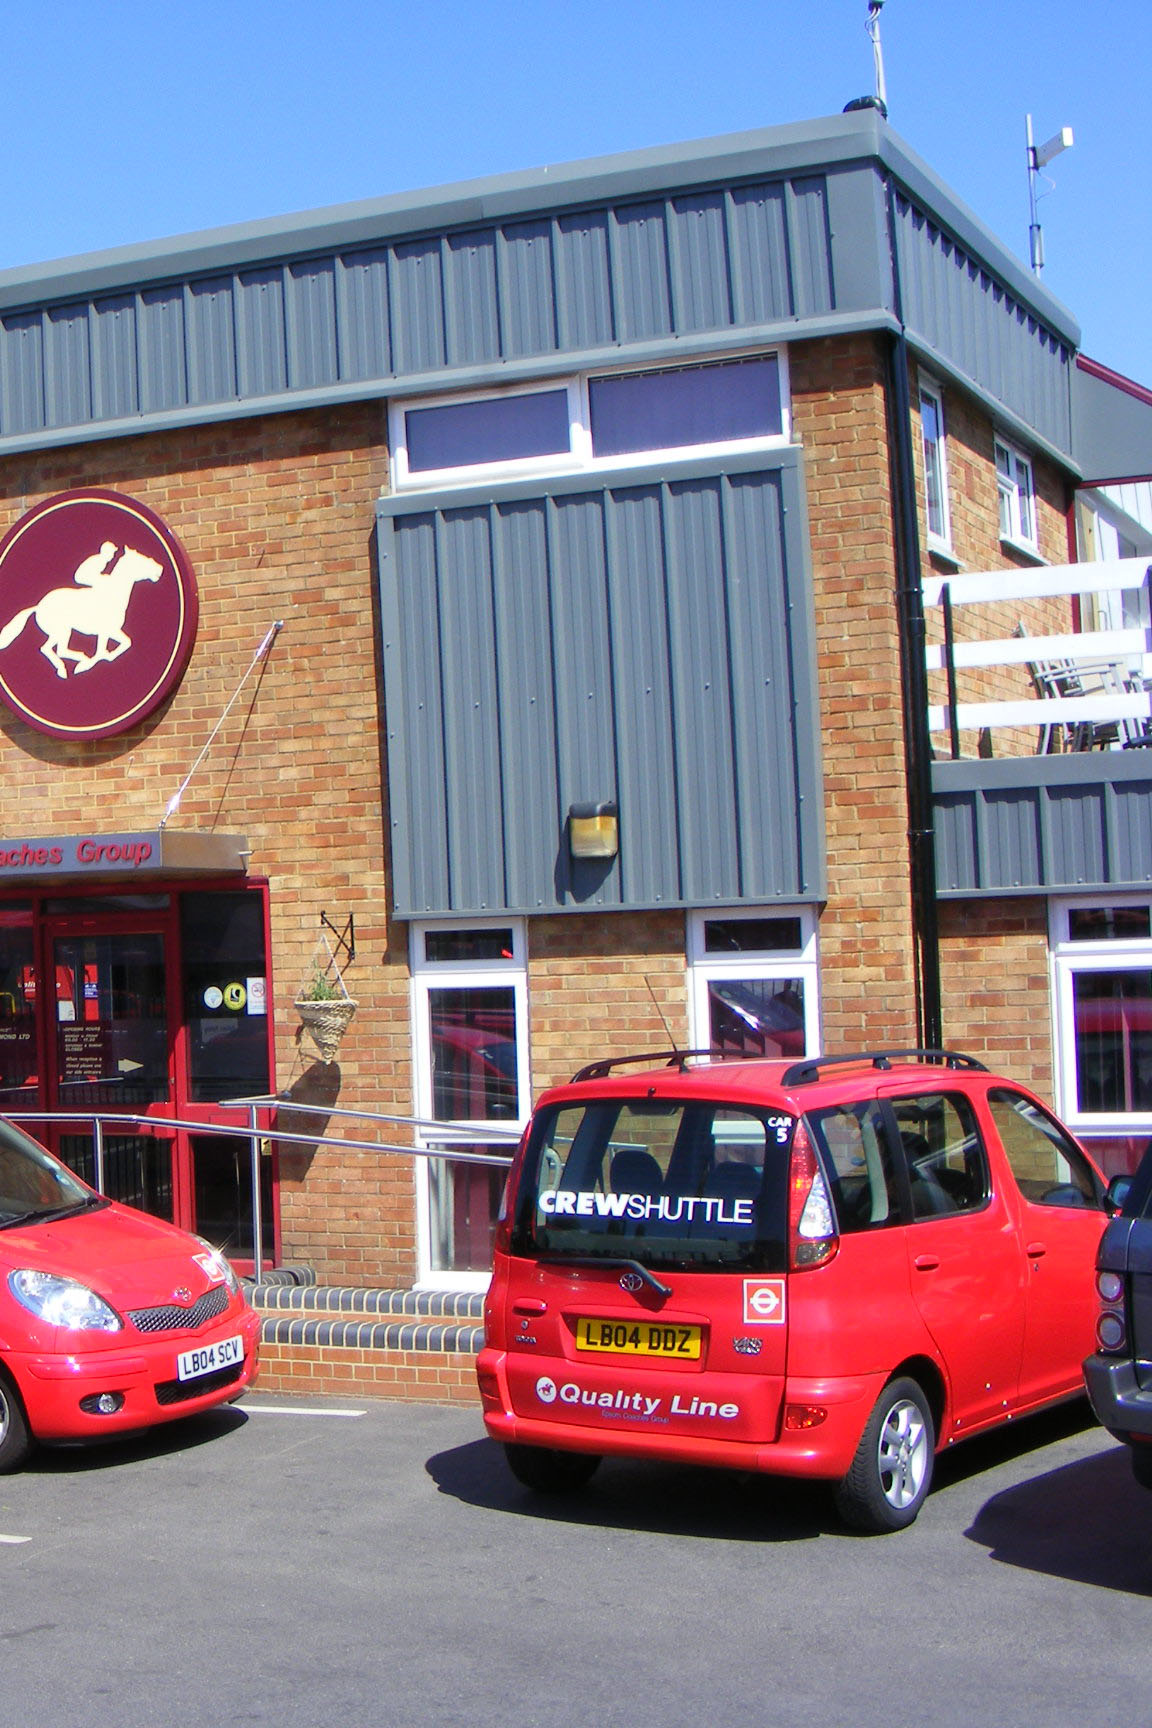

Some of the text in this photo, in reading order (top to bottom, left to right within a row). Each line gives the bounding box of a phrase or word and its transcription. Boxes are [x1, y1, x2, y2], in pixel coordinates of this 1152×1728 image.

[76, 839, 153, 866] Group
[768, 1116, 792, 1127] CAR
[776, 1127, 788, 1143] 5
[538, 1189, 754, 1224] CREWSHUTTLE
[585, 1323, 692, 1352] LB04 DDZ
[183, 1339, 238, 1375] LB04 SCV
[559, 1382, 740, 1418] Quality Line
[601, 1409, 670, 1425] Epsom Coaches Group
